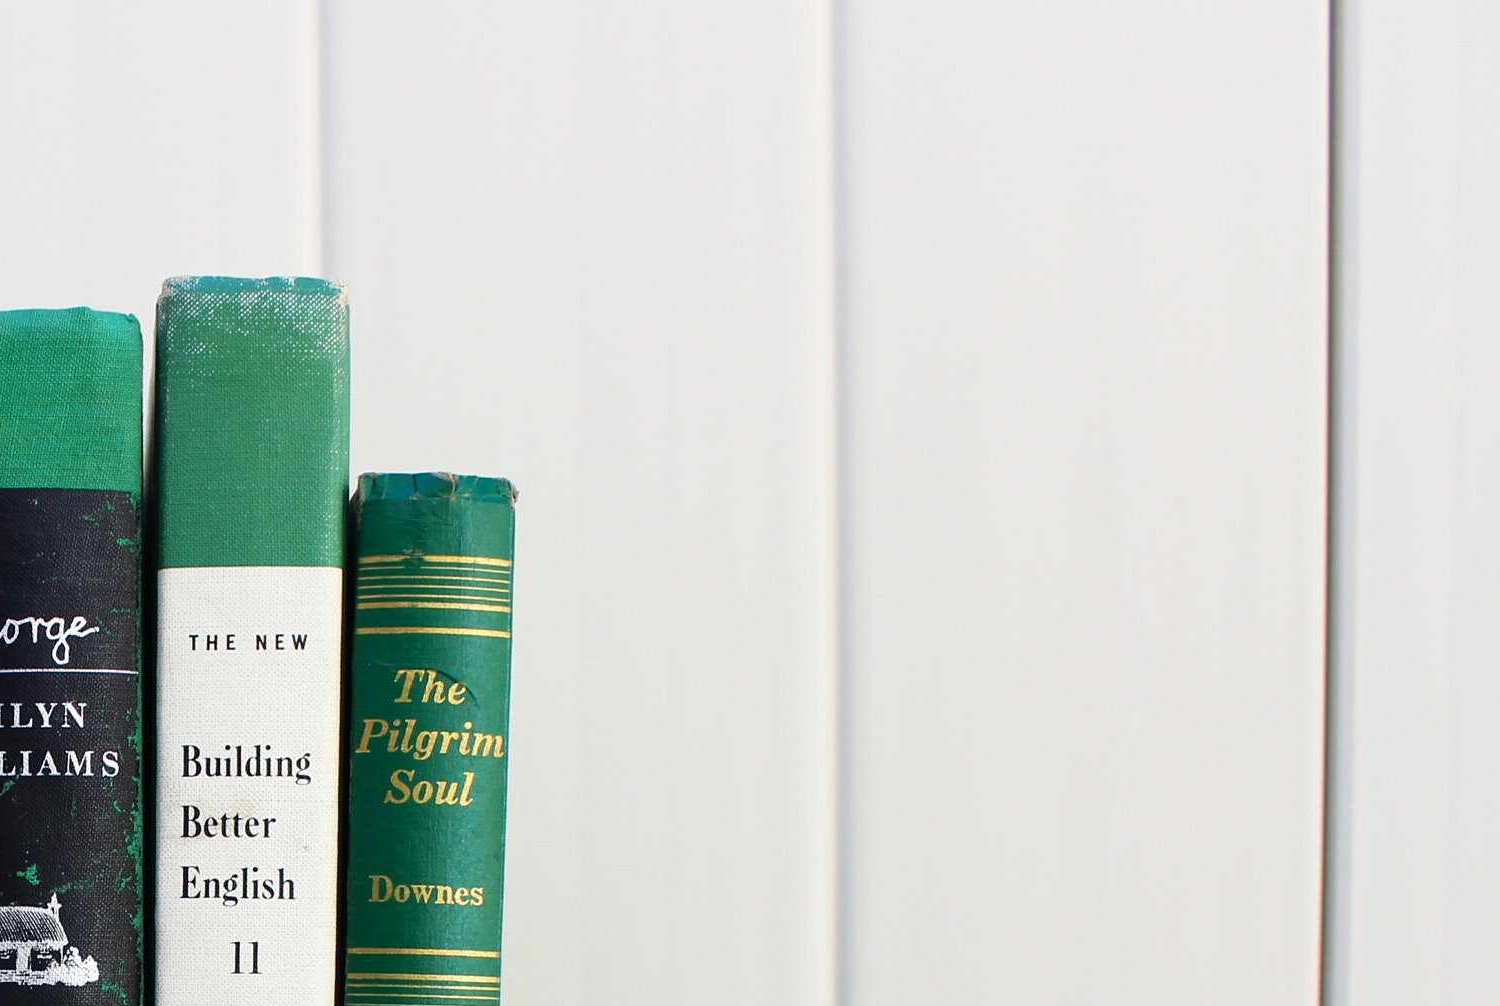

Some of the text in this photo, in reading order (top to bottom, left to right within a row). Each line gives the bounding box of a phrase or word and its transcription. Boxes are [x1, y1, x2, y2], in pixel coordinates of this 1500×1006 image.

[189, 634, 308, 651] THE NEW
[394, 669, 468, 705] The
[356, 718, 505, 760] Pilgrim
[181, 744, 312, 786] Building
[384, 769, 475, 806] Soul
[180, 804, 277, 838] Better
[180, 866, 296, 907] English
[368, 875, 485, 906] Downes
[230, 941, 263, 974] 11
